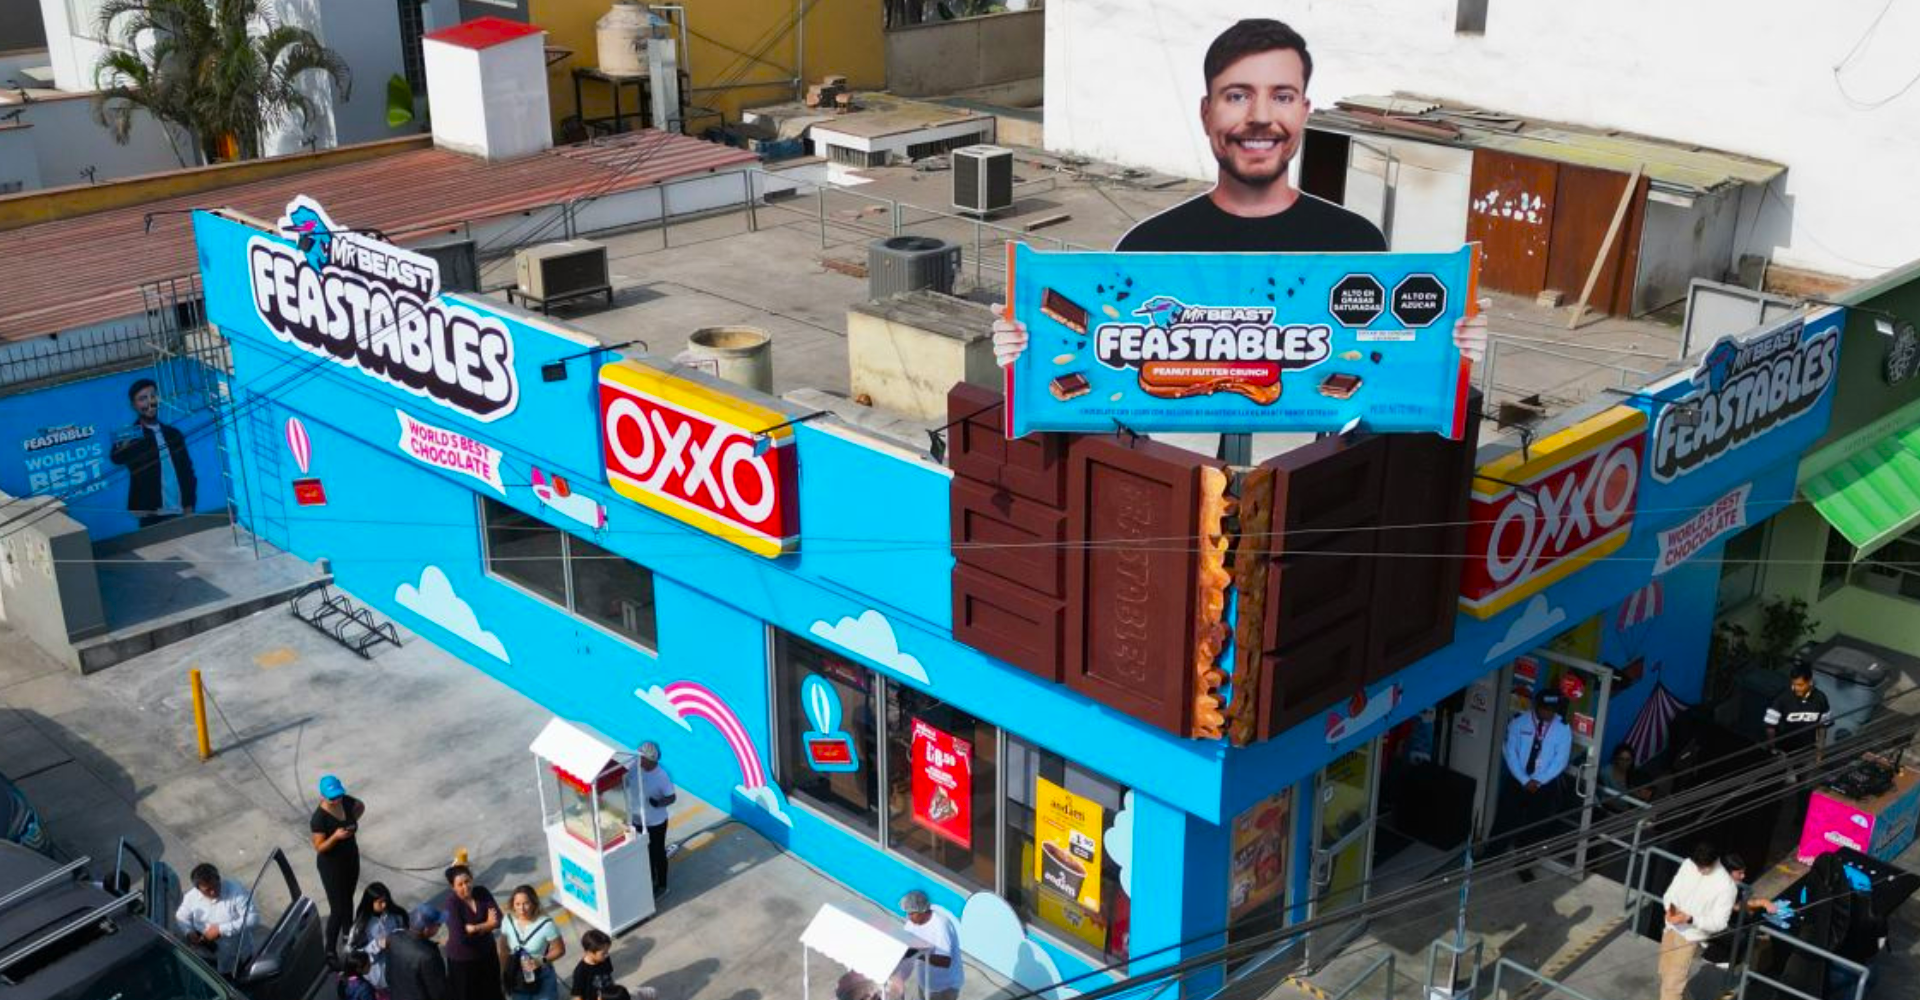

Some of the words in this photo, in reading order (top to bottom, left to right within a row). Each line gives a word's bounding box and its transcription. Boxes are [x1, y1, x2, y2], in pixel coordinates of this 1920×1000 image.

[358, 246, 433, 293] BEAST
[1341, 289, 1362, 297] ALTO
[1363, 289, 1375, 297] EN
[1401, 292, 1424, 300] ALTO
[1425, 292, 1438, 300] EN
[252, 249, 511, 403] FEASTABLES
[1207, 309, 1273, 321] BEAST
[1099, 326, 1330, 361] FEASTABLES
[1752, 327, 1801, 361] BEAST
[1153, 367, 1191, 376] PEANUT
[1192, 367, 1229, 376] BUTTER
[1230, 367, 1269, 377] CRUNCH
[1657, 336, 1837, 469] FEASTABLES
[23, 425, 96, 451] FEASTABLES
[460, 436, 490, 460] BEST
[24, 443, 102, 471] WORLD'S
[410, 437, 492, 480] CHOCOLATE
[606, 397, 775, 524] OXXO
[1487, 447, 1639, 583] OXXO
[1665, 508, 1738, 566] CHOCOLATE
